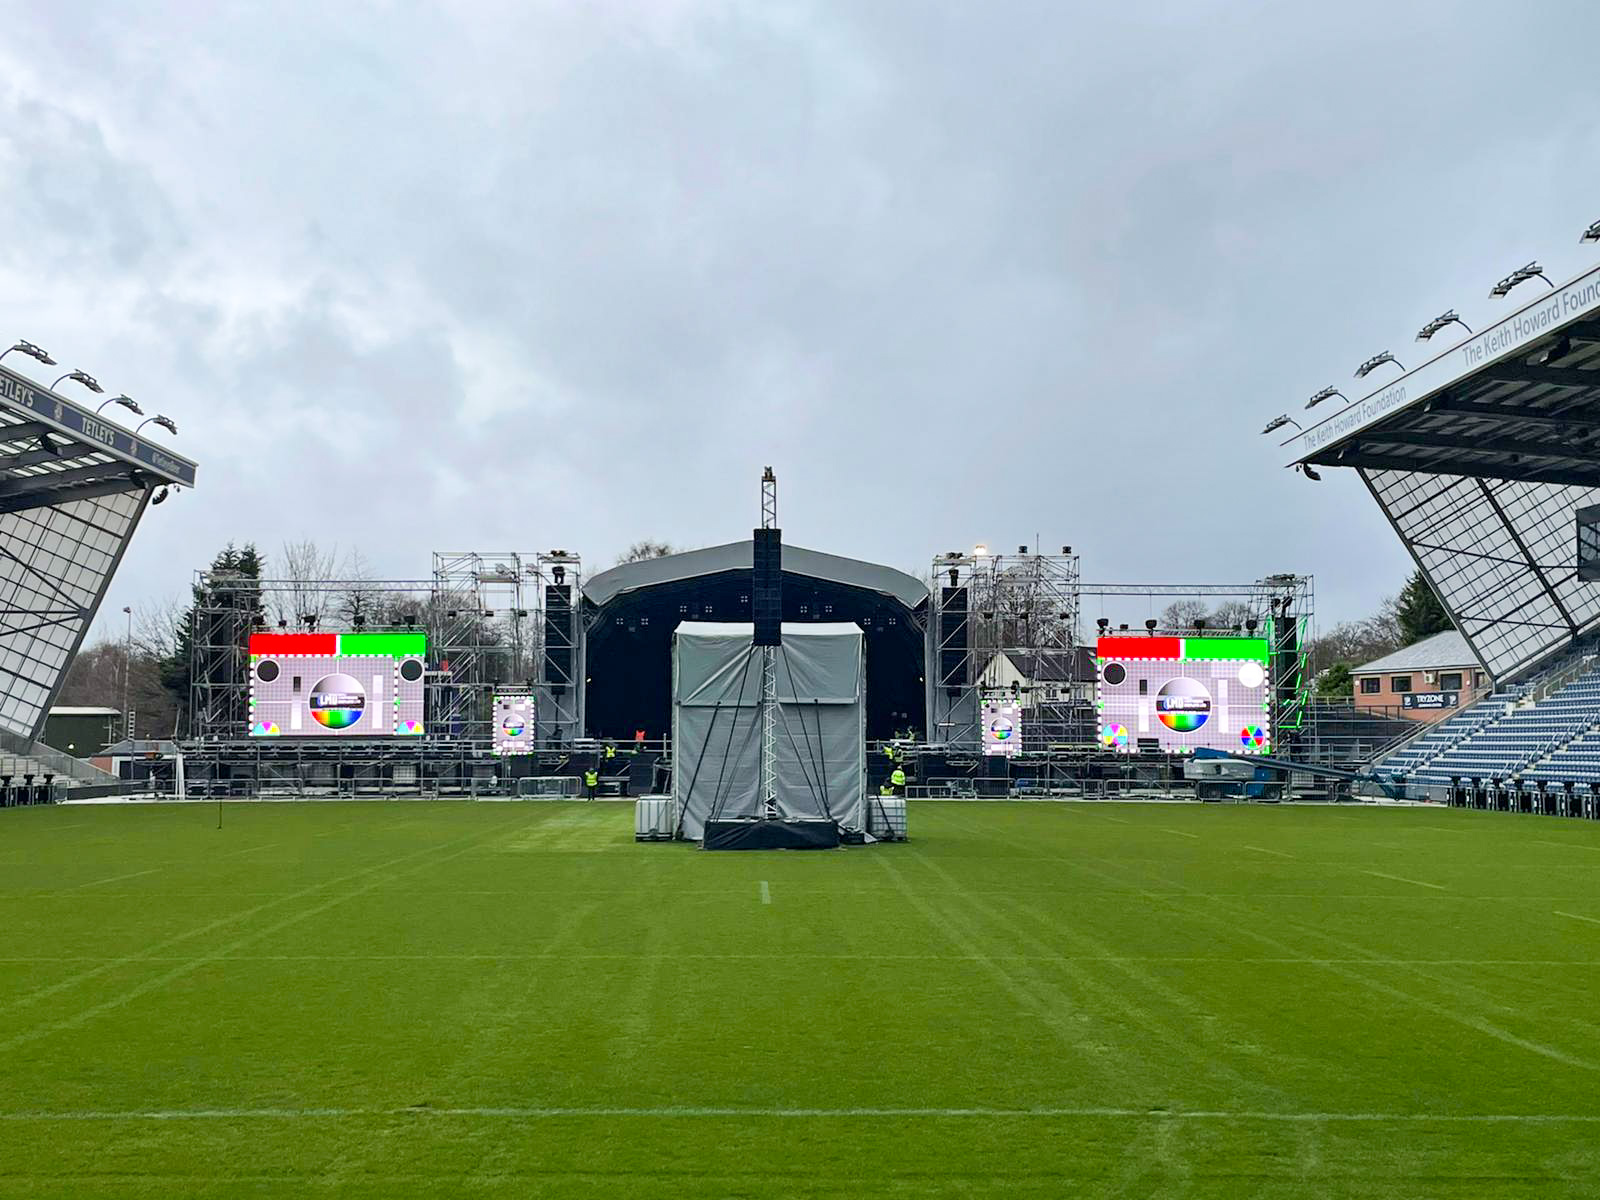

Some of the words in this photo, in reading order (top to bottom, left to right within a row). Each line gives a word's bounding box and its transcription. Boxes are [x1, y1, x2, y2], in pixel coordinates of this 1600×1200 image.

[1463, 345, 1482, 366] The
[1484, 327, 1512, 356] Keith
[1513, 297, 1560, 337] Howard
[81, 416, 115, 446] TETLEY'S
[1304, 434, 1316, 451] The
[1317, 424, 1333, 442] Keith
[1333, 409, 1362, 431] Howard
[1362, 386, 1407, 420] Foundation
